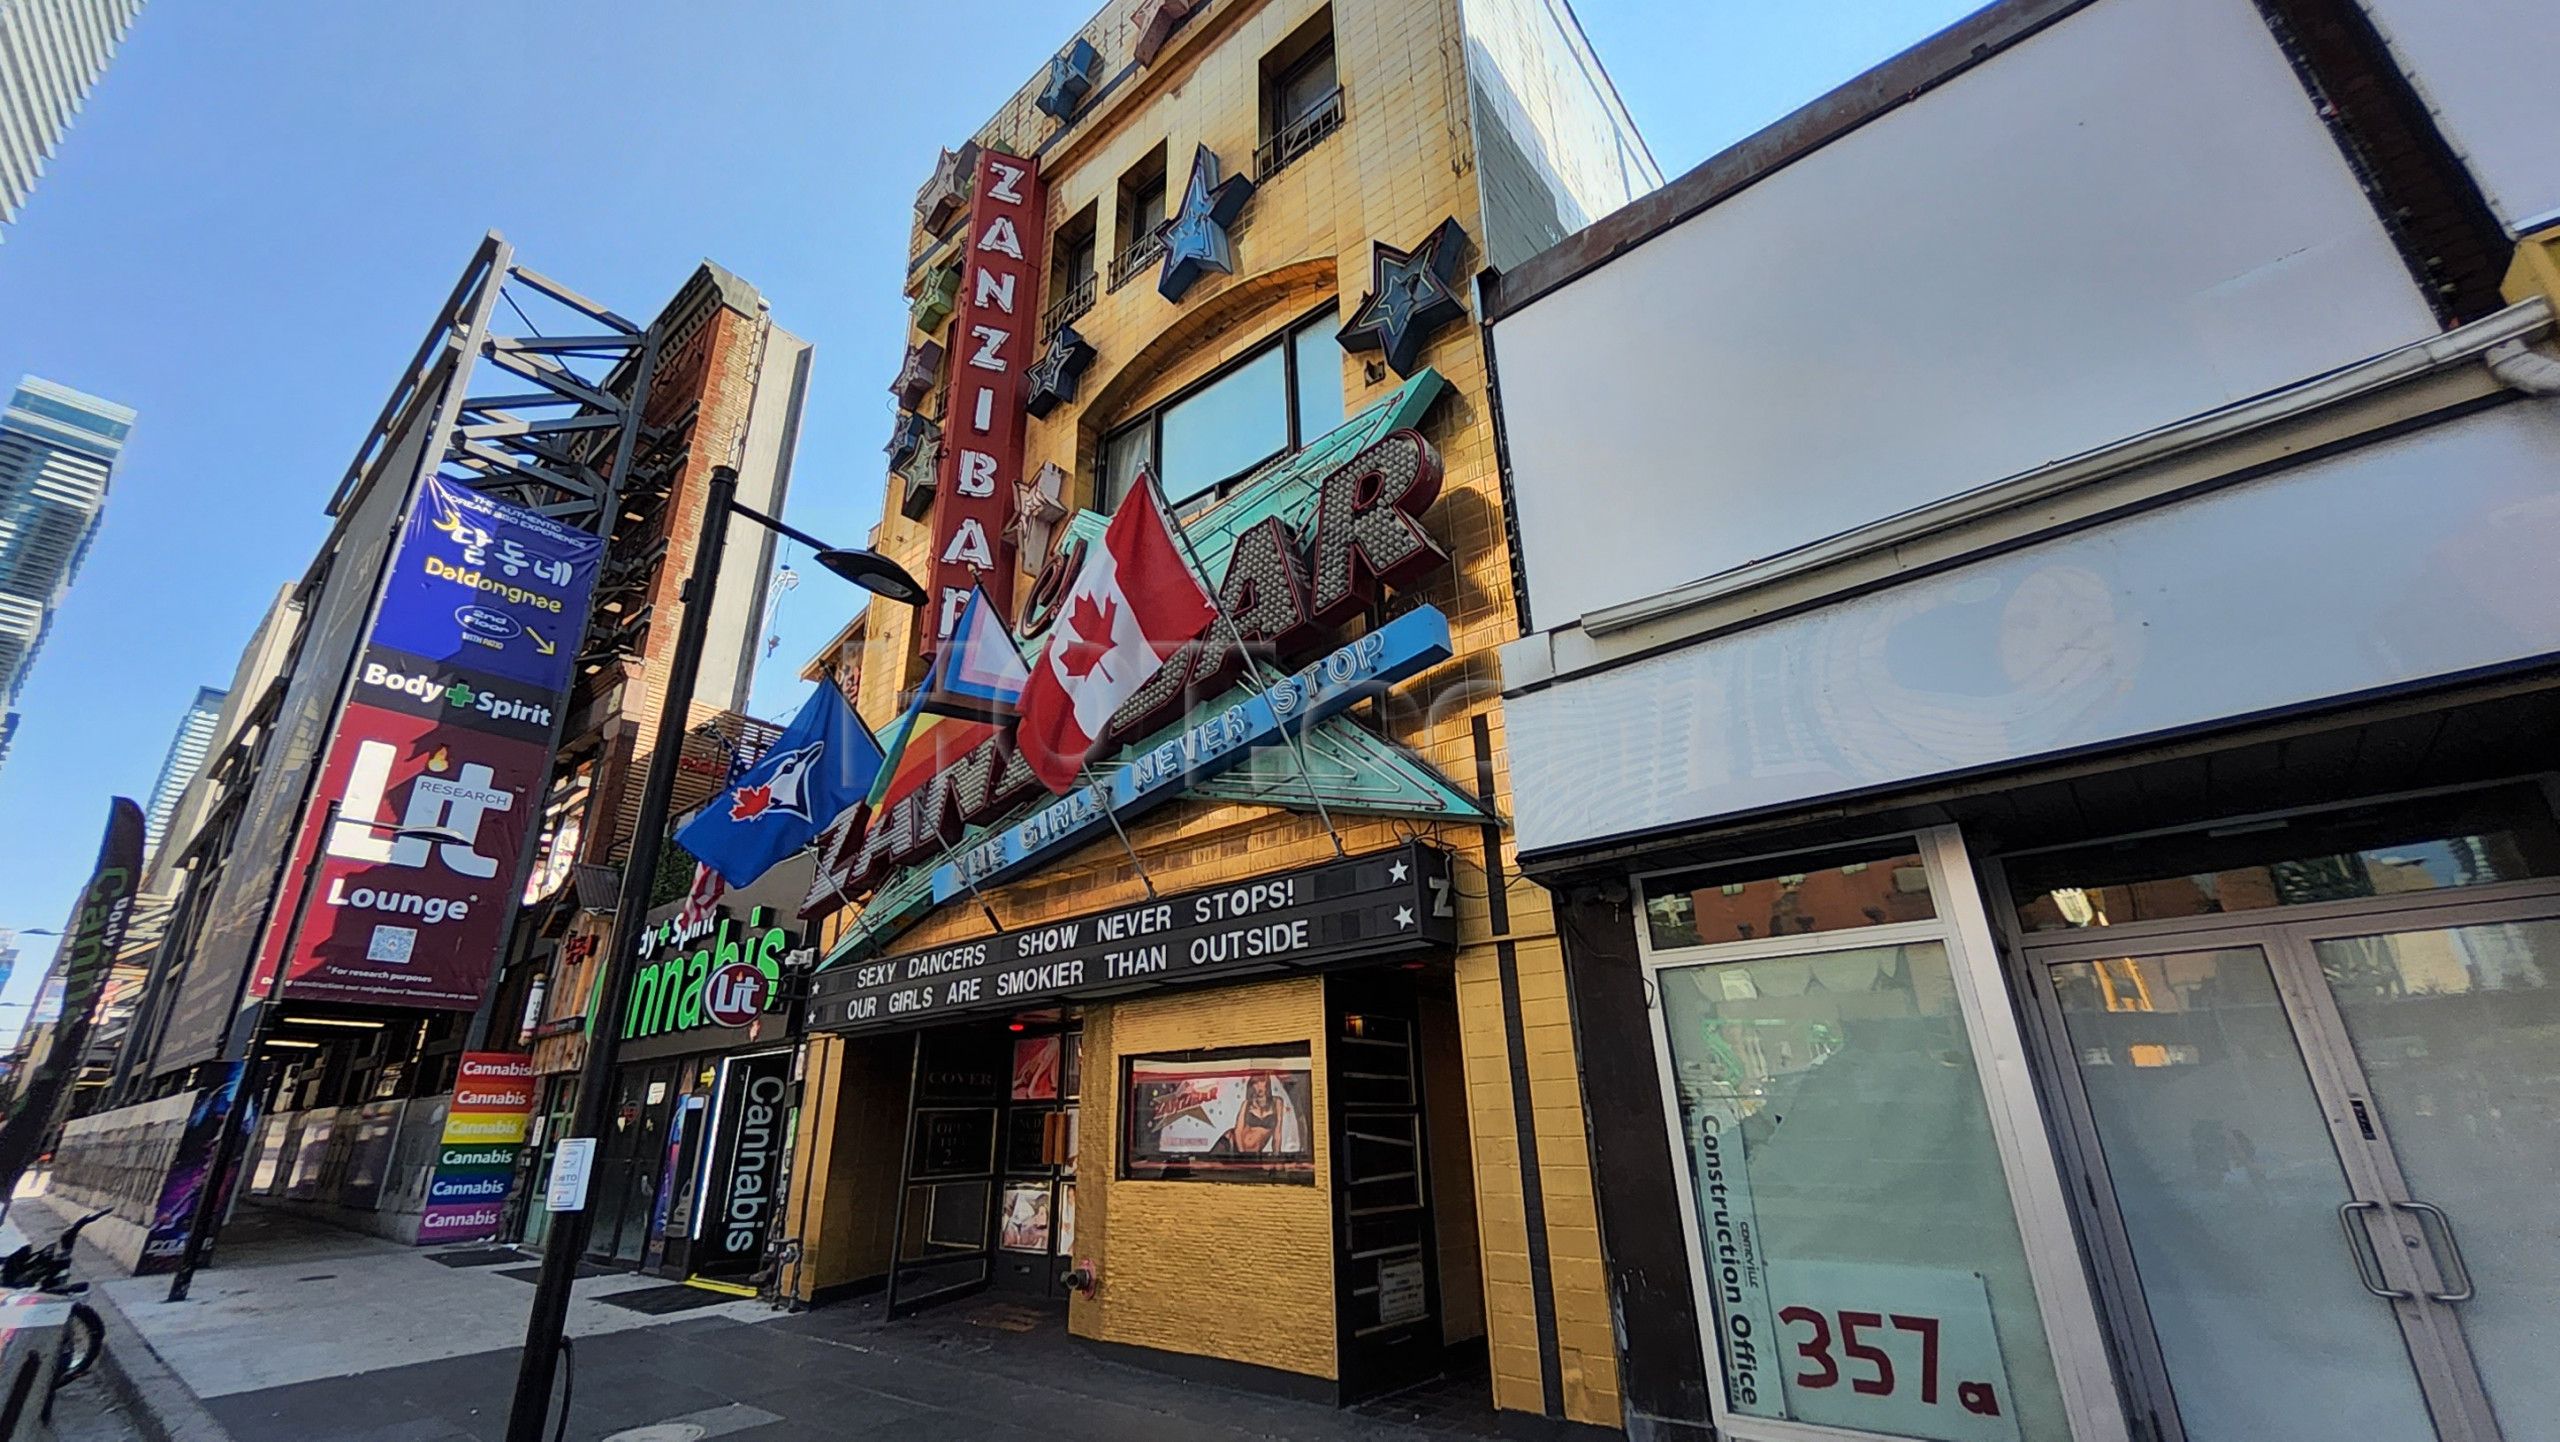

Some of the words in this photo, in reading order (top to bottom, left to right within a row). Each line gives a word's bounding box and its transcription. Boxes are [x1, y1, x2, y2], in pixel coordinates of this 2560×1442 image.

[472, 494, 498, 509] THE
[498, 505, 562, 533] AUTHENTIC
[519, 519, 587, 550] EXPERIENCE
[424, 555, 563, 614] Daldongnae
[463, 615, 511, 634] Floor
[472, 608, 507, 626] 2nd
[364, 662, 444, 704] Body
[477, 691, 554, 727] Spirit
[954, 836, 1009, 885] THE
[1018, 780, 1112, 851] GIRLS
[1132, 704, 1247, 789] NEVER
[1272, 629, 1384, 714] STOP
[326, 739, 514, 879] Lit
[419, 780, 509, 808] RESEARCH
[856, 959, 897, 989] SEXY
[907, 943, 987, 978] DANCERS
[1016, 922, 1079, 959] SHOW
[1096, 904, 1172, 942] NEVER
[1194, 881, 1296, 924] STOPS!
[846, 995, 877, 1020] OUR
[887, 986, 934, 1014] GIRLS
[945, 977, 982, 1004] ARE
[996, 960, 1084, 998] SMOKIER
[1103, 944, 1168, 977] THAN
[1189, 920, 1309, 964] OUTSIDE
[714, 973, 761, 1015] Lit
[463, 1060, 533, 1076] Cannabis
[457, 1090, 527, 1105] Cannabis
[448, 1119, 519, 1135] Cannabis
[442, 1149, 513, 1164] Cannabis
[726, 1075, 785, 1253] Cannabis
[432, 1179, 504, 1196] Cannabis
[424, 1211, 497, 1228] Cannabis
[1700, 1113, 1743, 1304] Construction
[1729, 1312, 1759, 1406] Office
